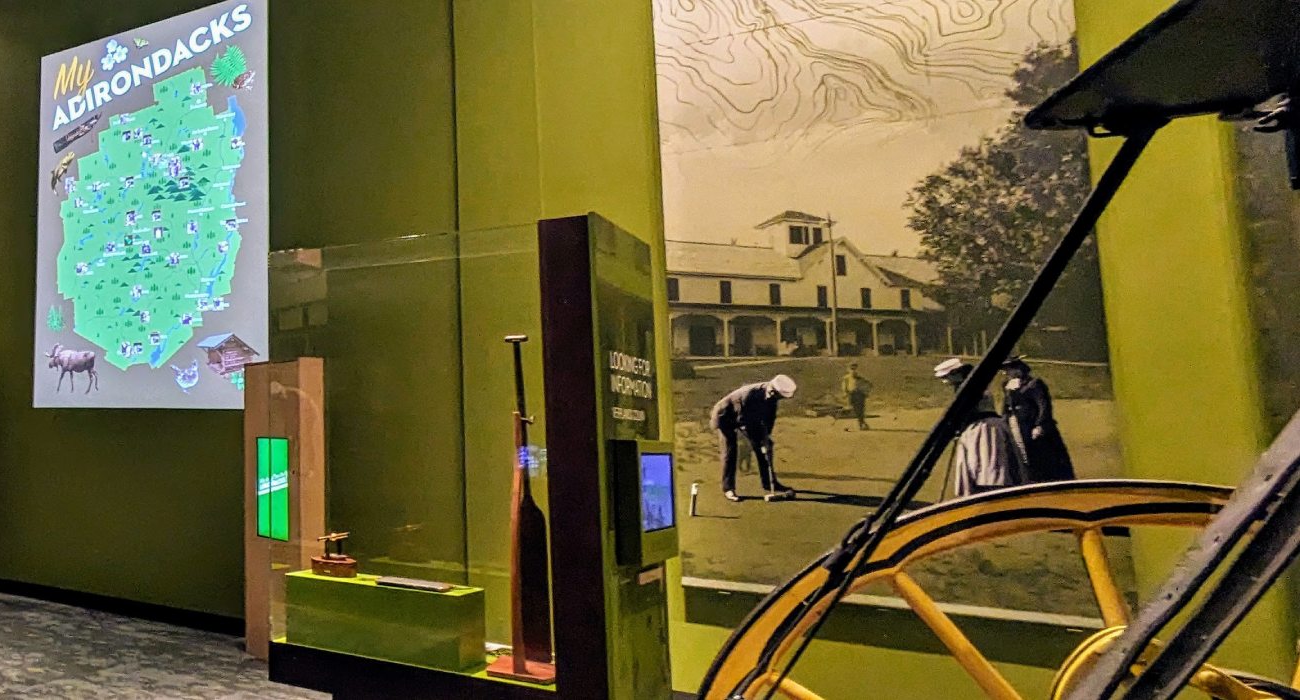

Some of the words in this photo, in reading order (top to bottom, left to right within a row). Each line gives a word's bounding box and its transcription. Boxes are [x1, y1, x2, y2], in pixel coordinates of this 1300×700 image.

[53, 4, 252, 131] ADIRONDACKS
[53, 56, 94, 100] My
[611, 374, 652, 399] INFORMATION
